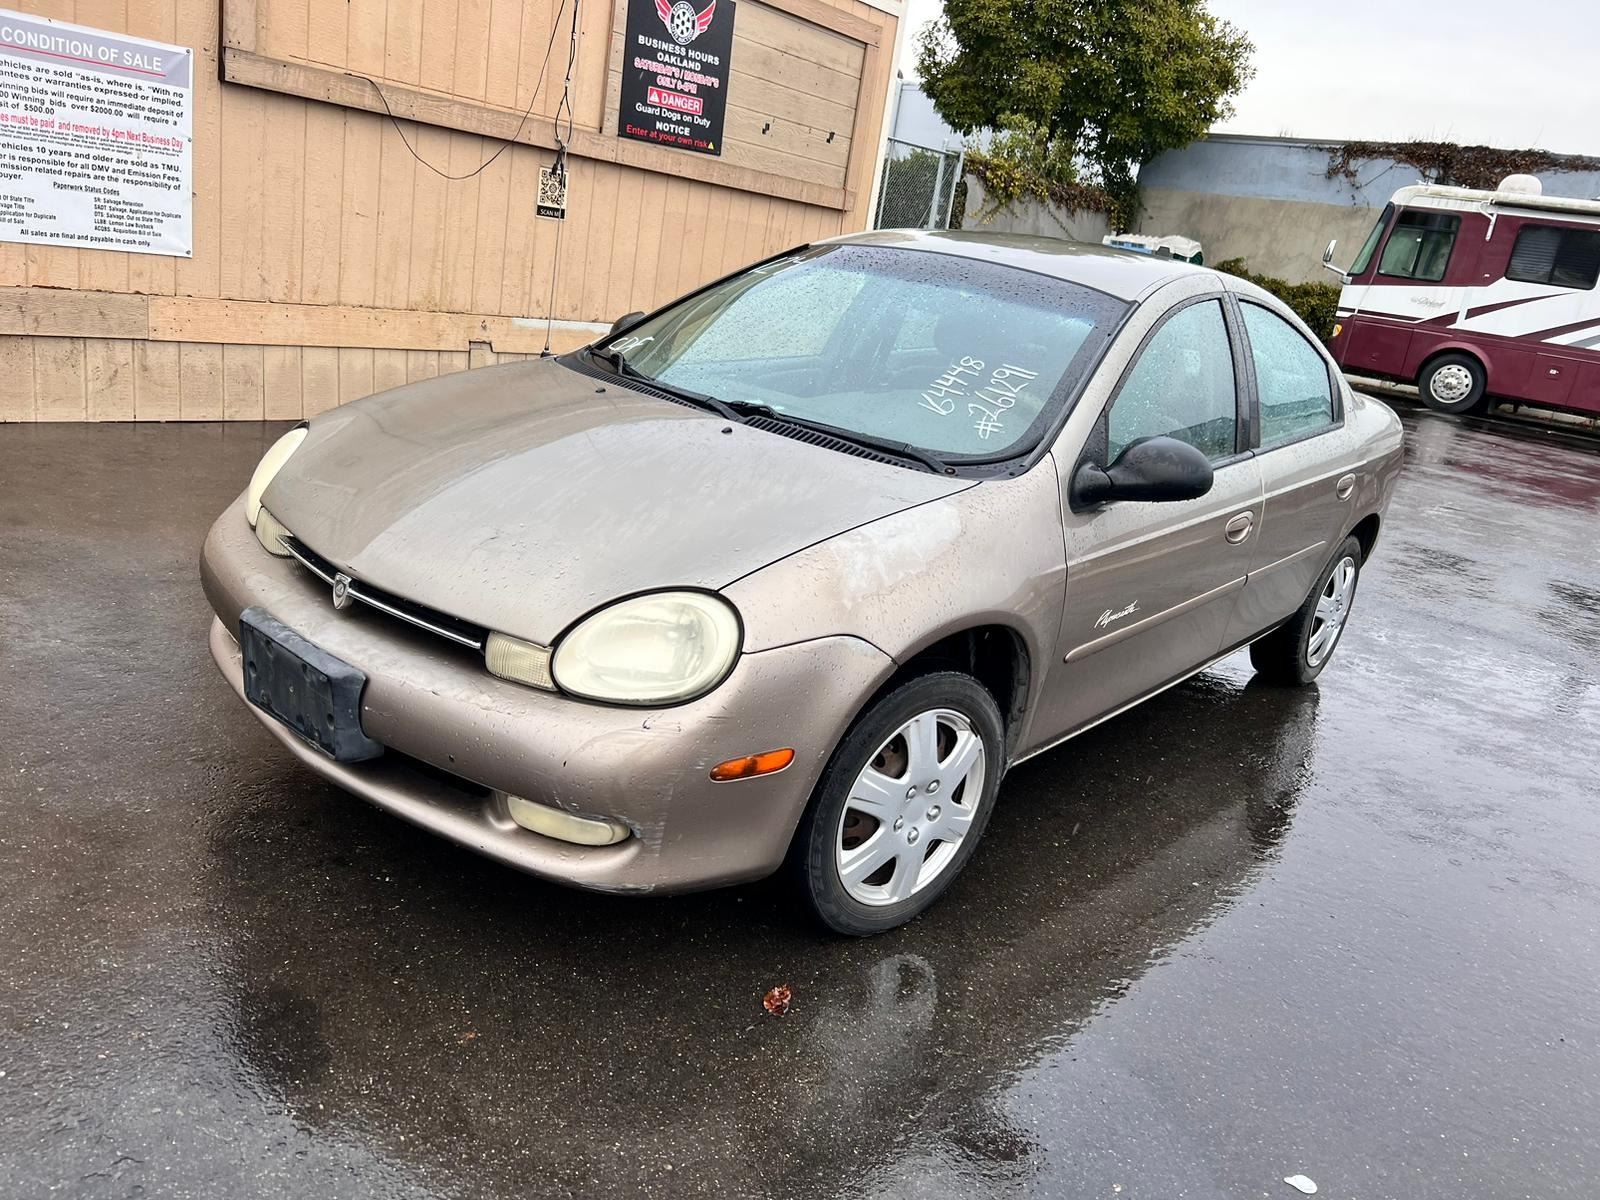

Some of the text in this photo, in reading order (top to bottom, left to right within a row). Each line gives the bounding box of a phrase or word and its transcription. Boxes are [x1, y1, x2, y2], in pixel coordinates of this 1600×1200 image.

[1, 26, 162, 72] CONDITION OF SALE
[638, 34, 720, 65] BUSINESS HOURS
[657, 52, 701, 71] OAKLAND
[36, 66, 50, 74] are
[53, 70, 72, 78] sold
[106, 80, 132, 89] where
[45, 78, 92, 92] warranties
[94, 86, 138, 100] expressed
[11, 92, 45, 106] Winning
[50, 98, 66, 108] bids
[71, 103, 88, 111] over
[90, 104, 124, 117] $2000.00
[144, 115, 170, 125] require
[24, 104, 55, 115] $500.00
[31, 86, 48, 96] bids
[66, 93, 94, 102] require
[108, 100, 146, 112] immediate
[148, 106, 174, 117] deposit
[660, 92, 700, 112] DANGER
[636, 102, 711, 128] Guard Dogs on Duty
[10, 115, 28, 126] must
[30, 115, 38, 126] be
[40, 118, 54, 130] paid
[58, 121, 70, 131] and
[72, 123, 100, 136] removed
[102, 126, 110, 138] by
[112, 128, 125, 140] 4pm
[126, 130, 140, 142] Next
[142, 132, 170, 146] Business
[172, 136, 183, 149] Day
[626, 124, 648, 136] Enter
[659, 133, 676, 142] your
[694, 138, 708, 148] risk
[656, 121, 690, 136] NOTICE
[0, 142, 33, 152] ehicles
[48, 149, 72, 157] years
[92, 154, 114, 163] older
[162, 163, 182, 172] TMU.
[18, 155, 65, 166] responsible
[92, 164, 110, 172] DMV
[128, 168, 160, 180] Emission
[0, 162, 32, 172] mission
[35, 166, 62, 176] related
[64, 170, 92, 179] repairs
[107, 174, 120, 182] the
[122, 178, 172, 190] responsibility
[52, 181, 120, 196] Paperwork Status Codes
[540, 208, 554, 216] SCAN
[1093, 600, 1140, 628] Plymouth
